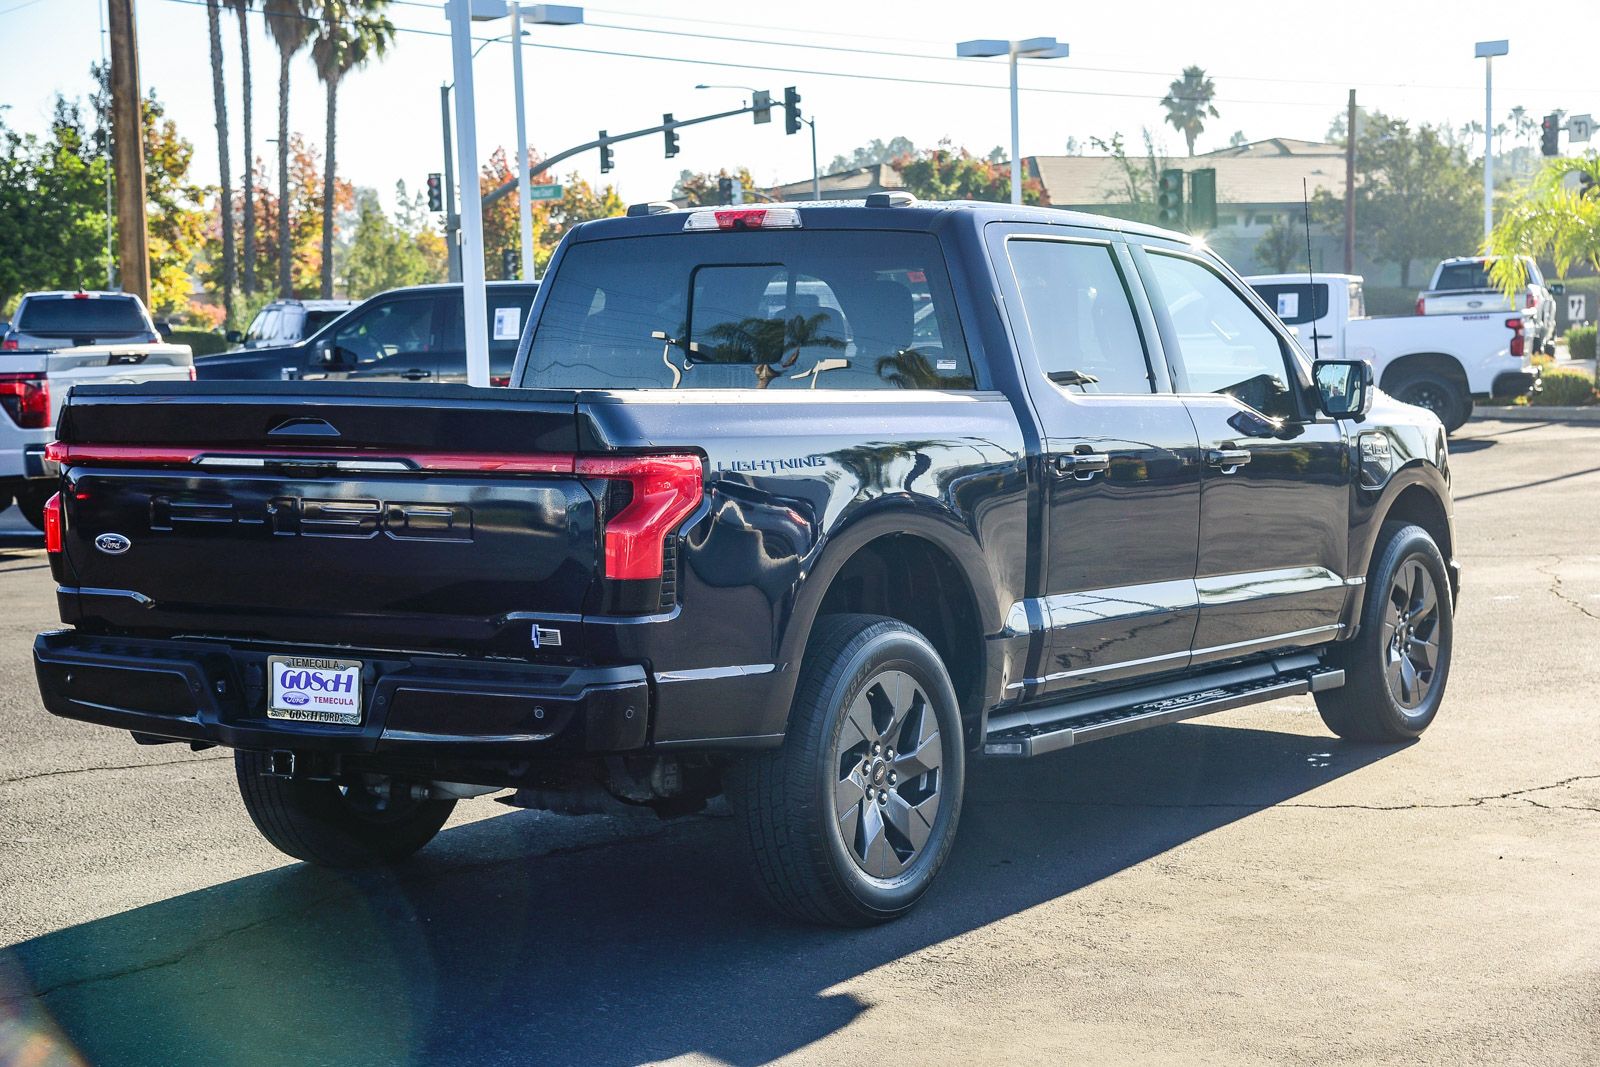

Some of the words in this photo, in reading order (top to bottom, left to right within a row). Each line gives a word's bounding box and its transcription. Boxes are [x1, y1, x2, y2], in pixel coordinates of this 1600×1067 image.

[717, 456, 827, 474] LIGHTNING
[290, 658, 339, 670] TEMECULA
[313, 696, 354, 706] TEMECULA
[320, 713, 340, 722] FORD
